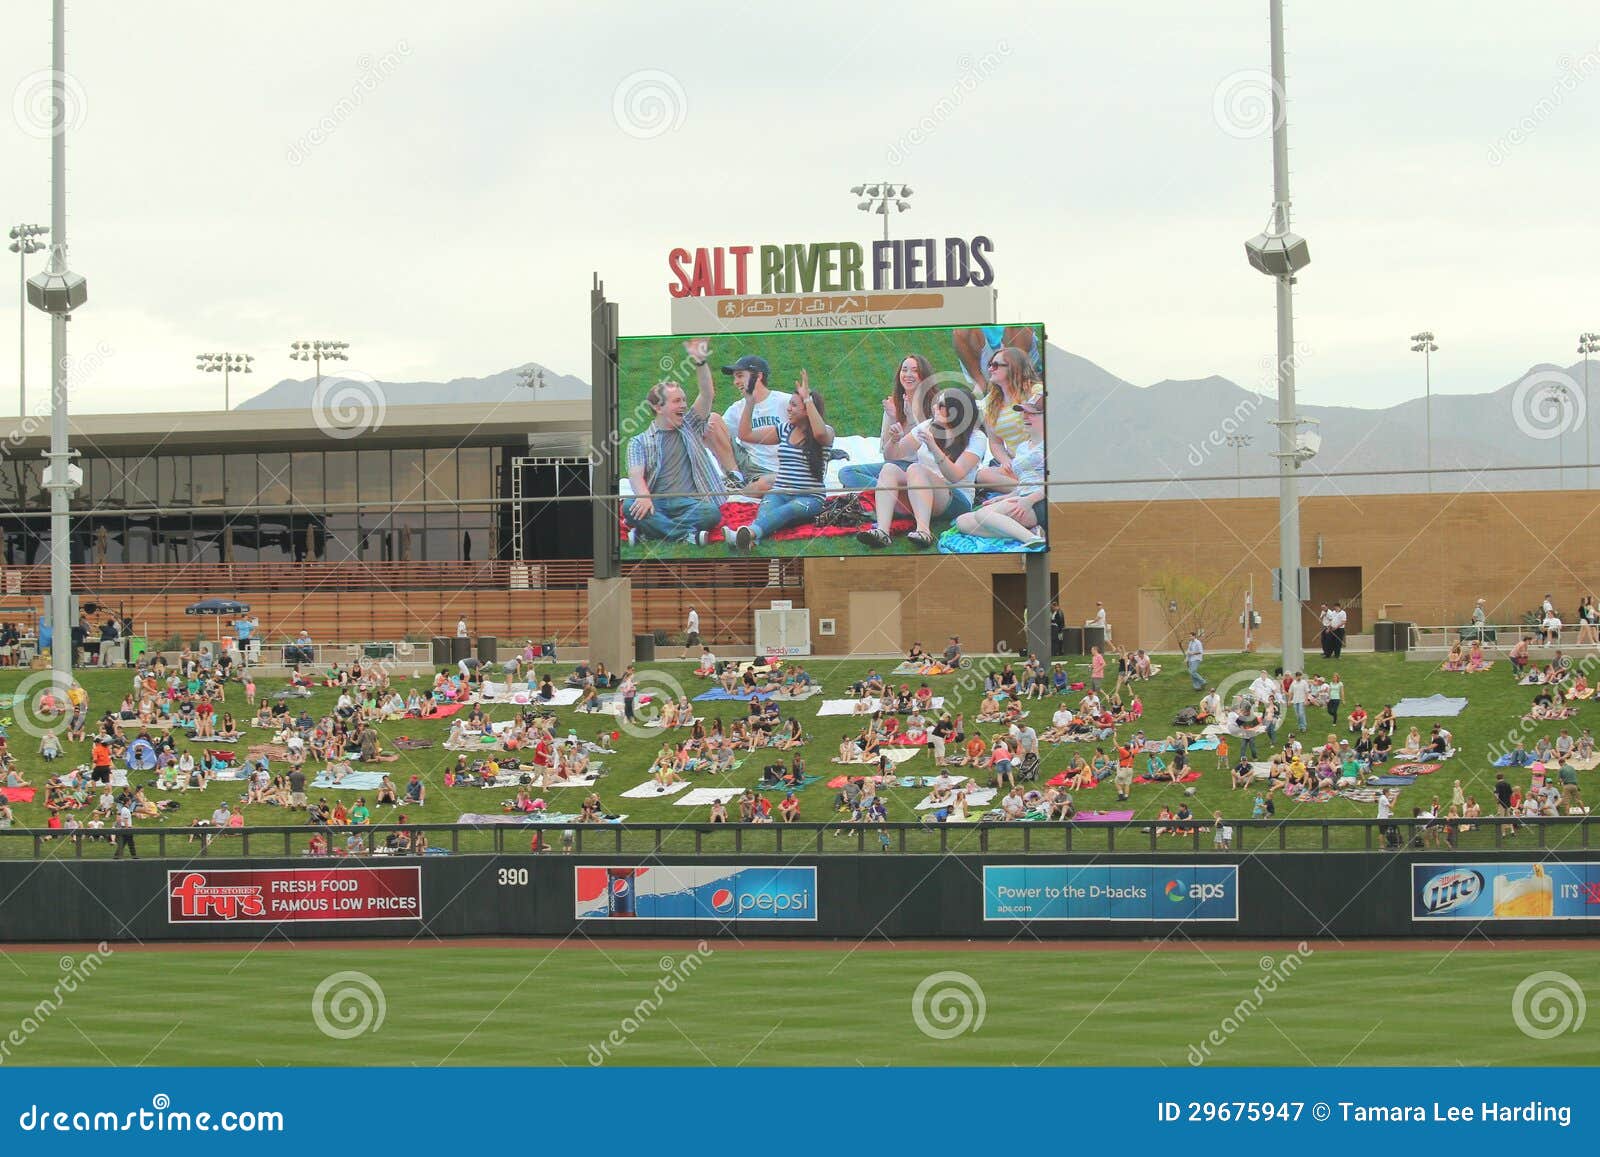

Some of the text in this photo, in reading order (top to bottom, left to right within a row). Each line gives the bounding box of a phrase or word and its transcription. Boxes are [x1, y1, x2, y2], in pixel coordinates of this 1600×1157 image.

[669, 235, 995, 298] SALT RIVER FIELDS
[775, 313, 887, 328] AT TALKING STICK
[498, 868, 529, 886] 390
[195, 887, 256, 895] FOOD STORES
[271, 879, 358, 893] FRESH FOOD
[997, 885, 1147, 899] Power to the D-backs
[1189, 883, 1225, 902] aps
[1561, 884, 1579, 898] IT'S
[171, 873, 265, 920] fry's
[271, 896, 417, 911] FAMOUS LOW PRICES
[738, 889, 810, 914] pepsi
[997, 905, 1033, 913] aps.com
